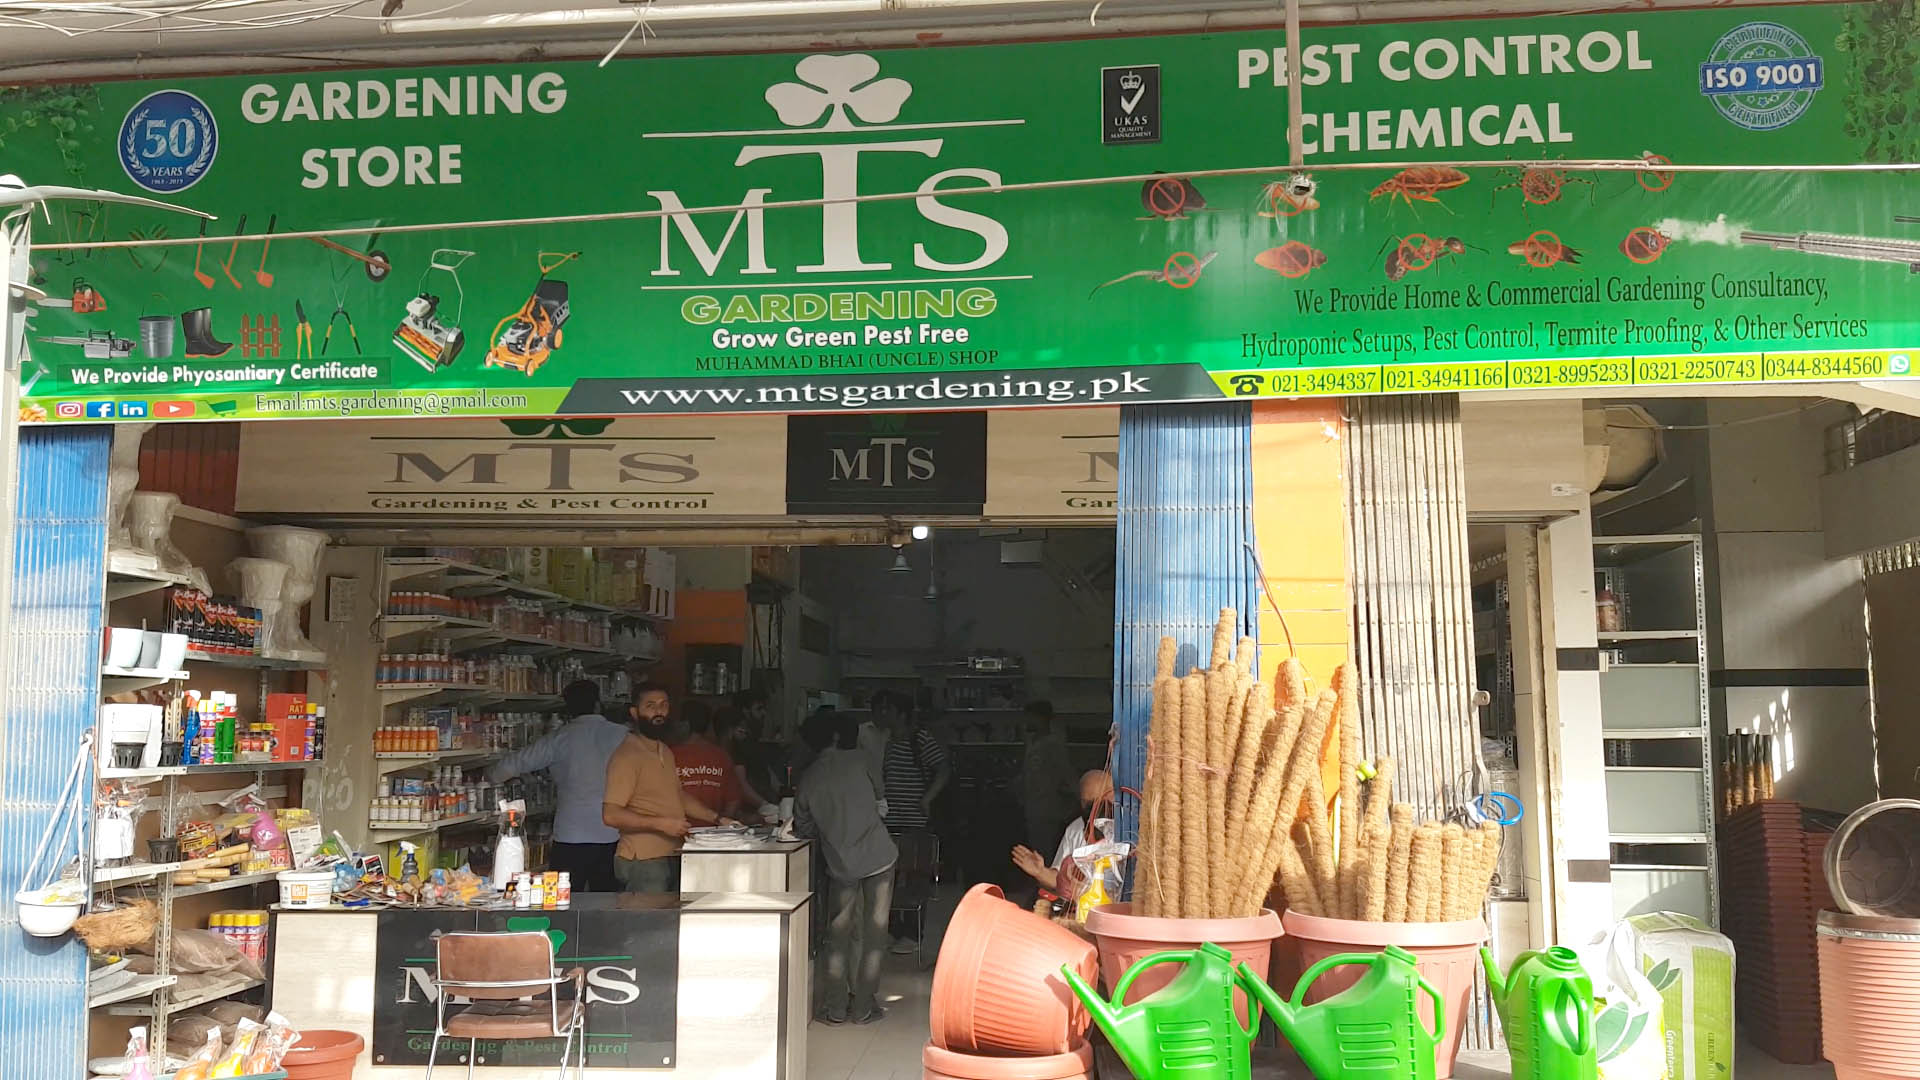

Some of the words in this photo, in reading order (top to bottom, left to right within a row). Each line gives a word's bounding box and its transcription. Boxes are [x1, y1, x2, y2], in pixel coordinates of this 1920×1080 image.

[1238, 43, 1360, 88] PEST
[1378, 30, 1652, 81] CONTROL
[1705, 66, 1747, 88] ISO
[1756, 63, 1816, 85] 9001
[241, 72, 567, 124] GARDENING
[142, 118, 195, 158] 50
[1114, 116, 1148, 126] UKAS
[1287, 102, 1573, 154] CHEMICAL
[151, 166, 183, 176] YEARS
[301, 144, 461, 189] STORE
[647, 138, 1009, 276] MTS
[681, 287, 997, 324] GARDENING
[1294, 289, 1322, 314] We
[1329, 285, 1398, 313] Provide
[1404, 284, 1460, 310] Home
[1466, 283, 1481, 307] &
[1487, 277, 1600, 307] Commercial
[1607, 276, 1705, 310] Gardening
[1711, 272, 1828, 306] Consultancy,
[712, 328, 778, 349] Grow
[785, 326, 857, 347] Green
[864, 325, 912, 345] Pest
[919, 323, 969, 343] Free
[1241, 330, 1347, 367] Hydroponic
[1352, 327, 1417, 361] Setups,
[1423, 325, 1458, 351] Pest
[1464, 321, 1539, 351] Control,
[1545, 320, 1617, 347] Termite
[1624, 316, 1708, 352] Proofing,
[1713, 317, 1729, 342] &
[1734, 313, 1788, 340] Other
[1793, 312, 1868, 339] Services
[71, 368, 99, 384] We
[104, 367, 168, 384] Provide
[173, 365, 286, 386] Phyosantiary
[290, 362, 378, 380] Certificate
[695, 354, 813, 371] MUHAMMAD
[818, 353, 864, 369] BHAI
[869, 350, 944, 368] (UNCLE)
[949, 349, 999, 366] SHOP
[1272, 371, 1377, 393] 021-3494337
[1386, 367, 1503, 388] 021-34941166
[1513, 362, 1629, 384] 0321-8995233
[1639, 359, 1756, 380] 0321-2250743
[1766, 355, 1883, 377] 0344-8344560
[256, 389, 527, 416] Email:mts.gardening@gmail.com
[620, 371, 1151, 408] www.mtsgardening.pk
[384, 444, 700, 490] MTS
[829, 438, 936, 487] MTS
[371, 497, 508, 511] Gardening
[517, 498, 539, 510] &
[551, 497, 600, 510] Pest
[610, 497, 708, 510] Control
[396, 966, 640, 1005] MS
